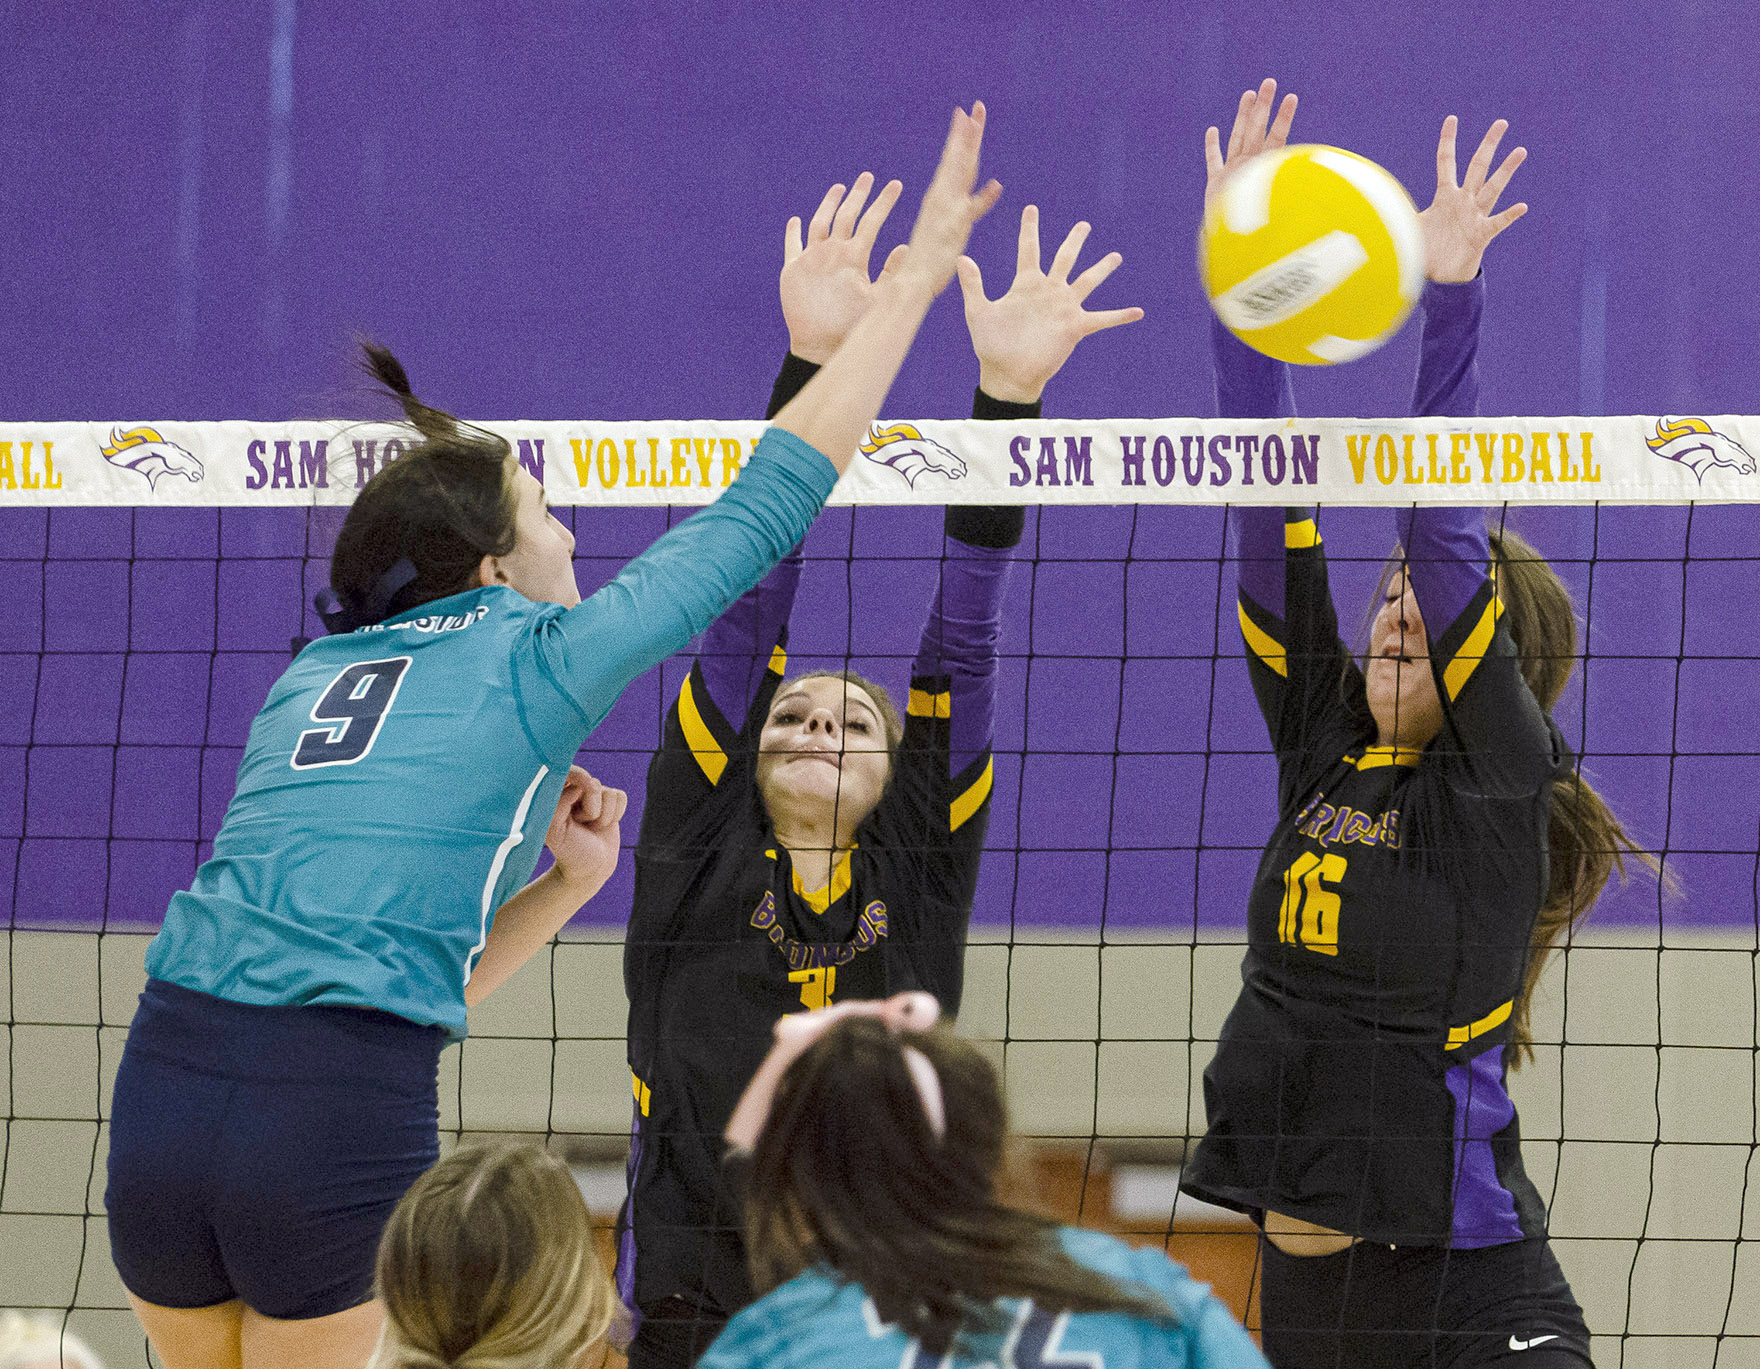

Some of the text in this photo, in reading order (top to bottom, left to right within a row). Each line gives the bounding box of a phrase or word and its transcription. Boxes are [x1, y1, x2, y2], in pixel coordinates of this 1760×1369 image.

[246, 439, 328, 489] SAM
[569, 437, 759, 489] VOLLEYB
[1009, 432, 1601, 487] SAM HOUSTON VOLLEYBALL
[290, 655, 414, 771] 9
[1278, 851, 1348, 956] 16
